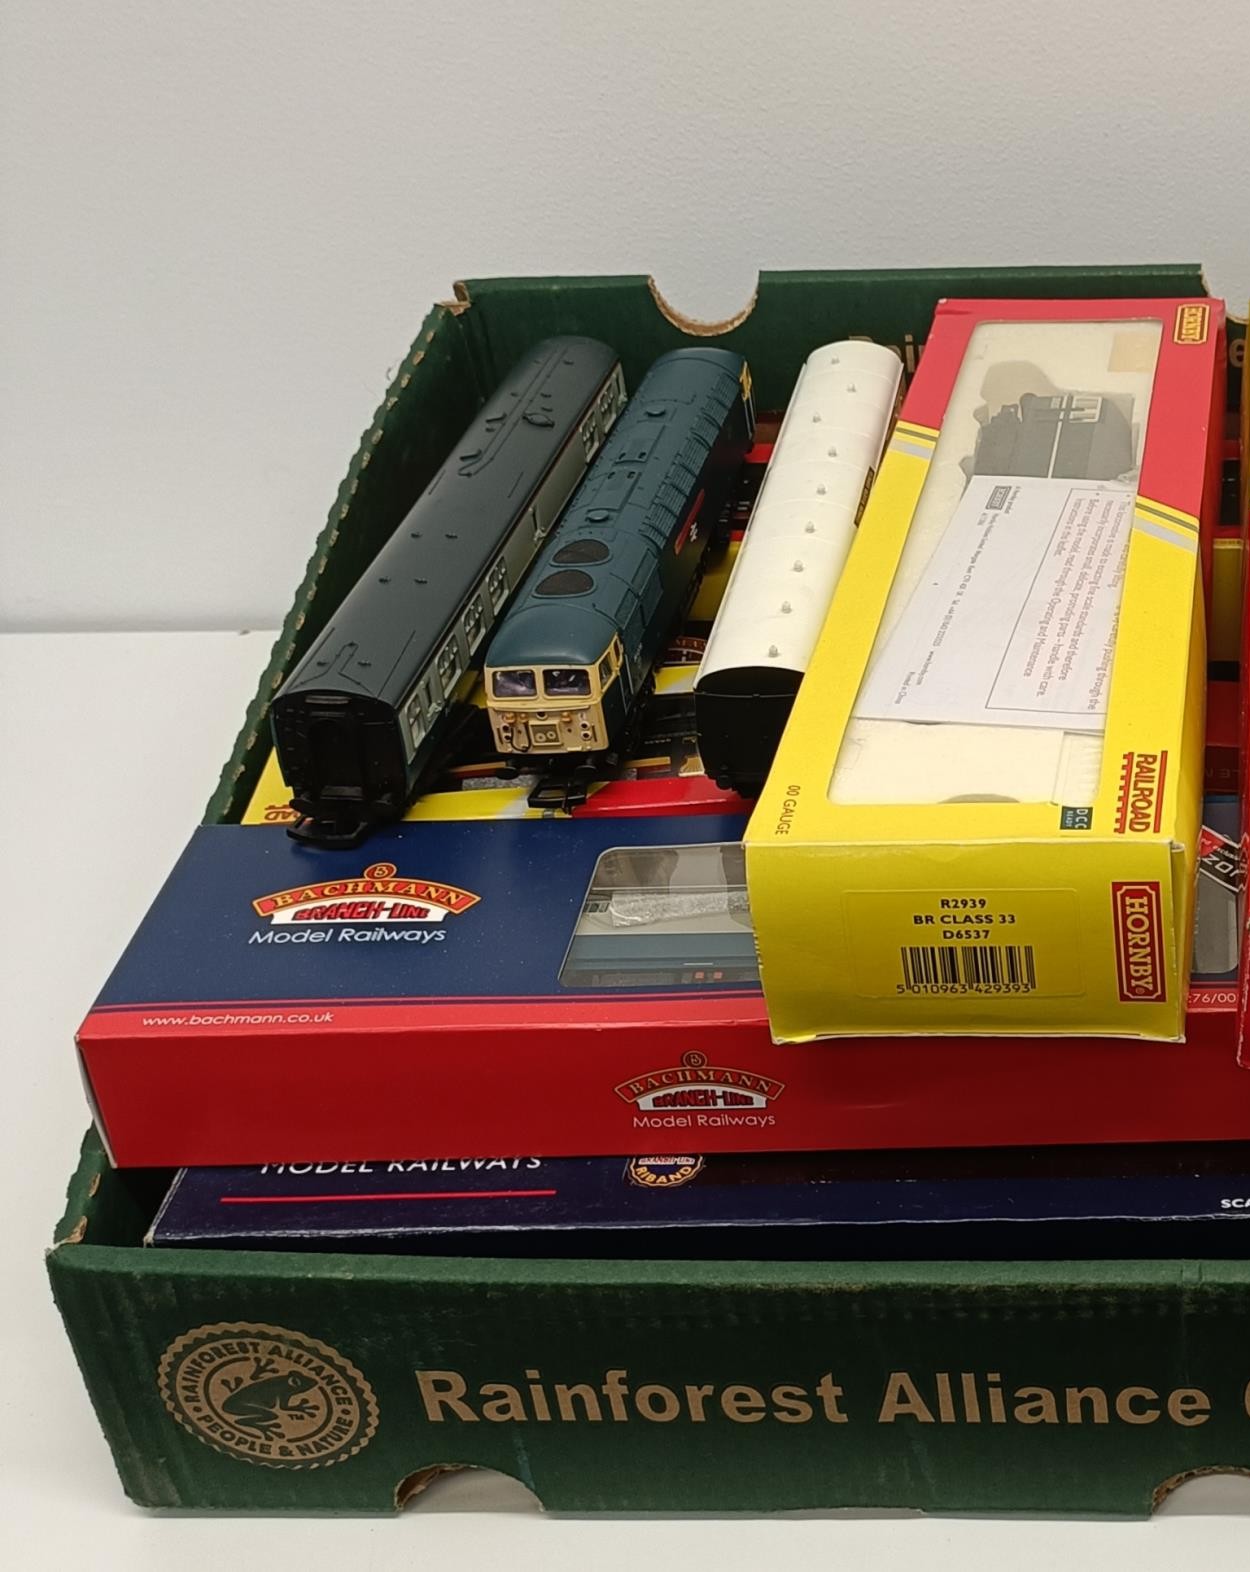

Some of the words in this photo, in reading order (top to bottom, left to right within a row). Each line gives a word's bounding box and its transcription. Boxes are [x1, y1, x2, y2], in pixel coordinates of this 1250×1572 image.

[1129, 753, 1158, 832] RAILROAD
[775, 799, 797, 835] GAUGE
[1074, 808, 1088, 829] DCC
[273, 881, 462, 908] BACHMANN
[940, 898, 987, 909] R2939
[913, 915, 935, 925] BR
[940, 914, 994, 924] CLASS
[998, 914, 1016, 924] 33
[248, 928, 331, 944] Model
[338, 927, 447, 944] Railways
[943, 929, 991, 940] D6537
[911, 984, 968, 994] 010963
[974, 983, 1031, 994] 429393
[142, 1011, 335, 1026] www.bachmann.co.uk
[628, 1068, 772, 1095] BACHMANN
[633, 1115, 692, 1128] Model
[697, 1114, 776, 1128] Railways
[636, 1166, 692, 1184] RIBAND
[183, 1341, 261, 1403] RAINFOREST
[268, 1344, 353, 1407] ALLIANCE
[414, 1367, 850, 1425] Rainforest
[877, 1371, 1213, 1428] Alliance
[197, 1414, 272, 1455] PEOPLE
[278, 1446, 294, 1457] &
[296, 1418, 354, 1457] NATURE
